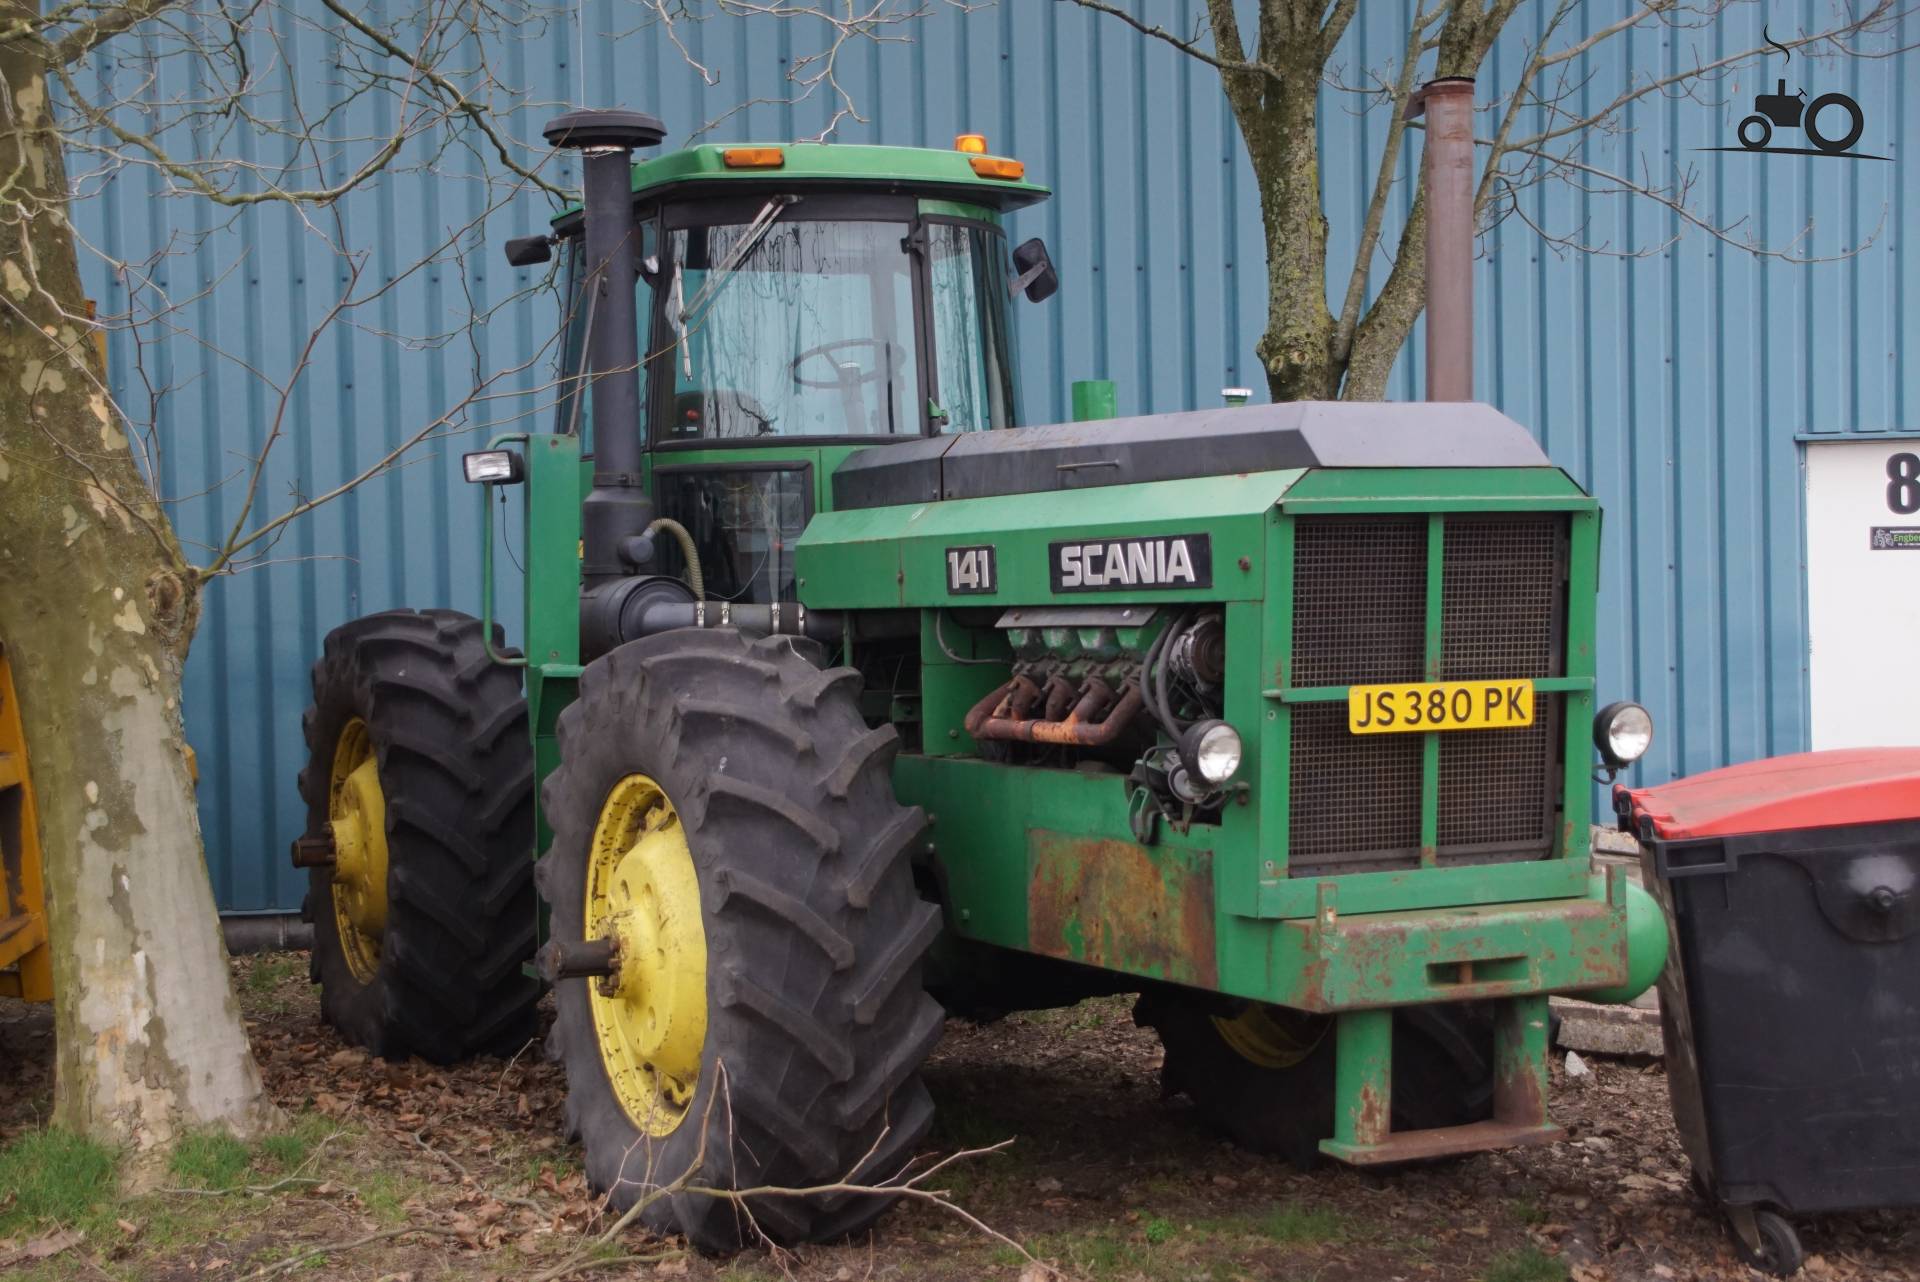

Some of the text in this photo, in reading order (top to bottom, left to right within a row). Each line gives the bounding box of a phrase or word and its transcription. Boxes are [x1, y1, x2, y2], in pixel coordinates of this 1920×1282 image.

[1886, 452, 1920, 515] 8
[1893, 534, 1920, 543] Engbe
[949, 550, 990, 589] 141
[1061, 540, 1196, 587] SCANIA
[1357, 686, 1526, 727] JS 380 PK
